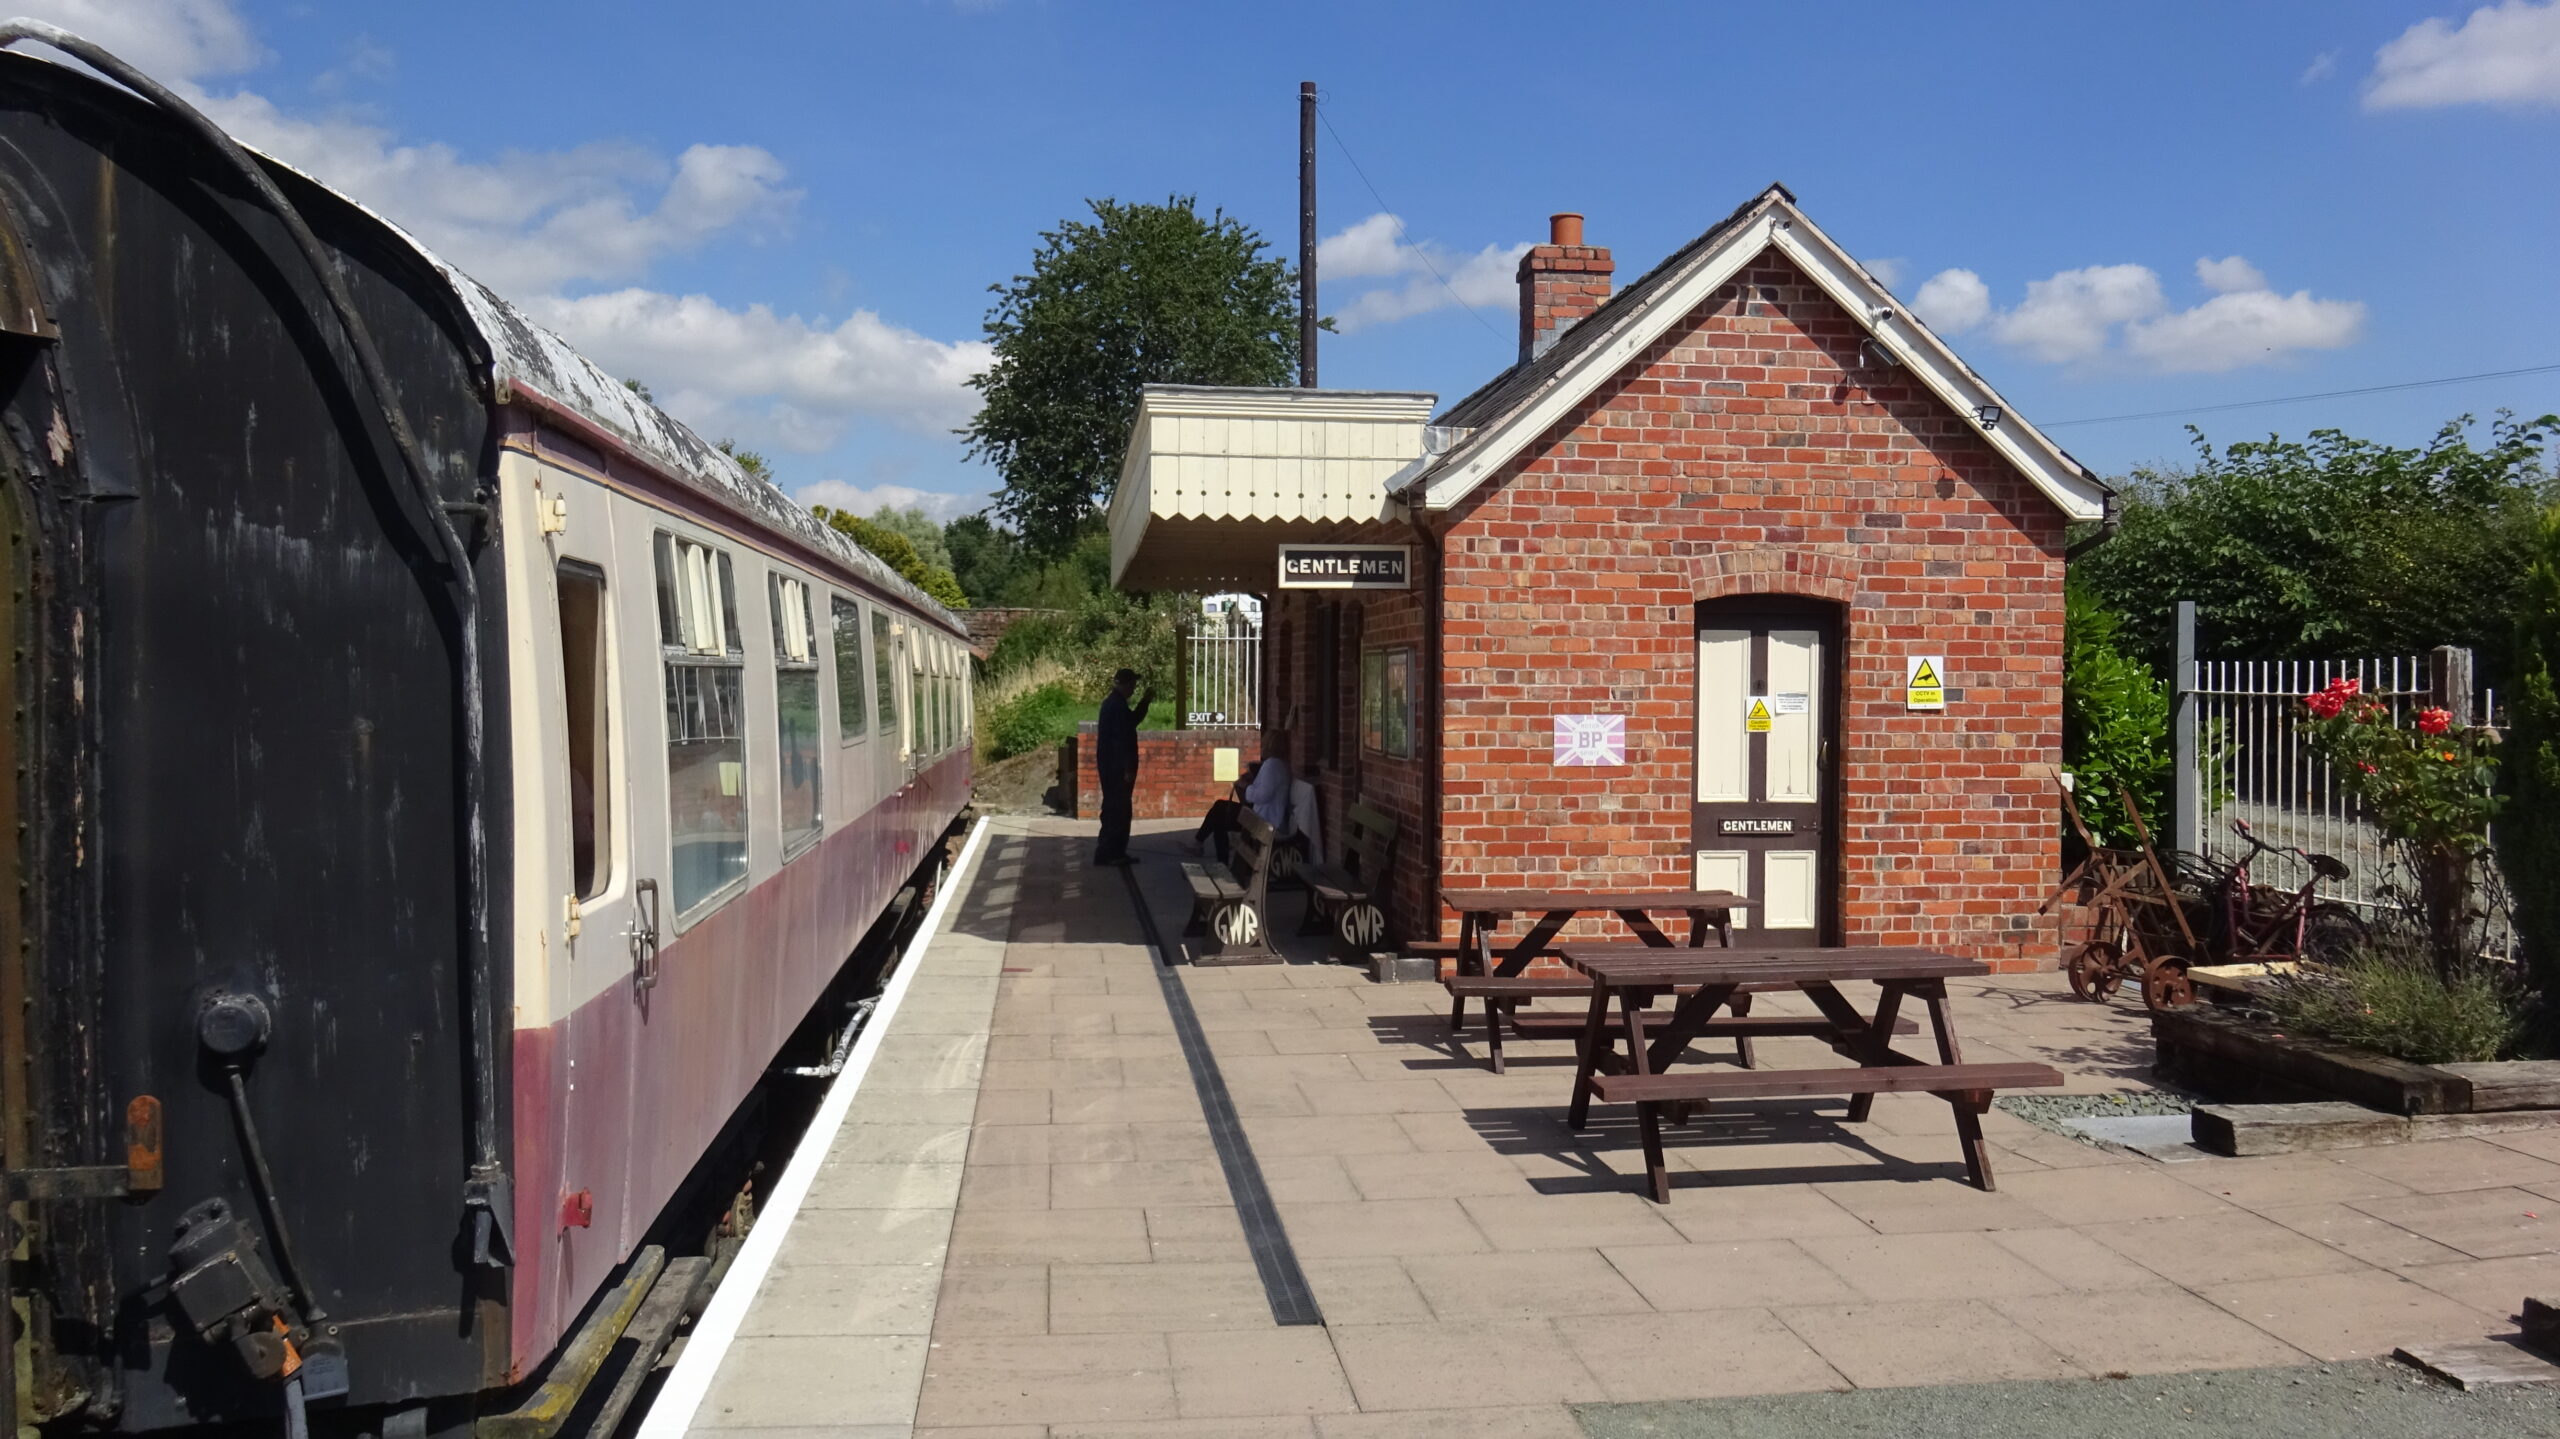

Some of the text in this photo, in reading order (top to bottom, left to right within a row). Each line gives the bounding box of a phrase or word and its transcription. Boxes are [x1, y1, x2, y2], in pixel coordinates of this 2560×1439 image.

[1287, 559, 1403, 575] GENTLEMEN
[1188, 712, 1212, 722] EXIT
[1578, 731, 1602, 748] BP
[1723, 820, 1792, 831] GENTLEMEN
[1214, 903, 1258, 946] GWR
[1341, 904, 1385, 946] GWR
